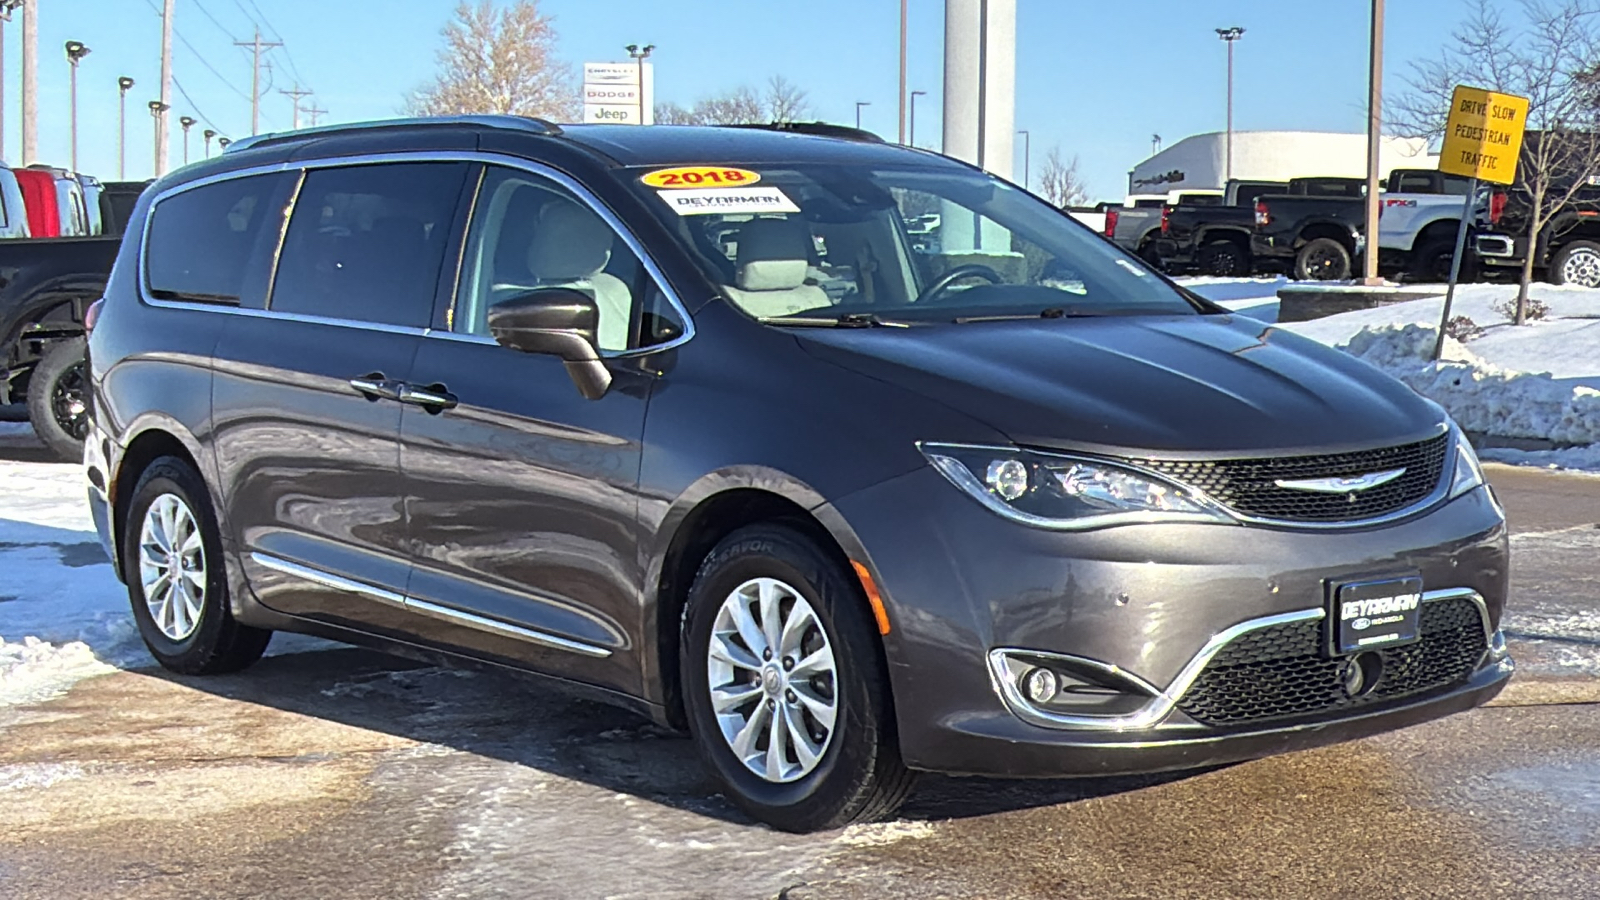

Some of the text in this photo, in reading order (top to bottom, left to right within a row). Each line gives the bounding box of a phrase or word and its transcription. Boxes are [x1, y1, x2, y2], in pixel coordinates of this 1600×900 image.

[595, 108, 628, 121] Jeep
[1460, 99, 1516, 121] DRIVE SLOW
[1454, 123, 1511, 145] PEDESTRIAN
[1460, 150, 1498, 170] TRAFFIC
[659, 170, 747, 185] 2018
[677, 195, 781, 206] DEYARMAN
[1386, 199, 1417, 208] FX4
[1341, 594, 1420, 619] DEYARMAN
